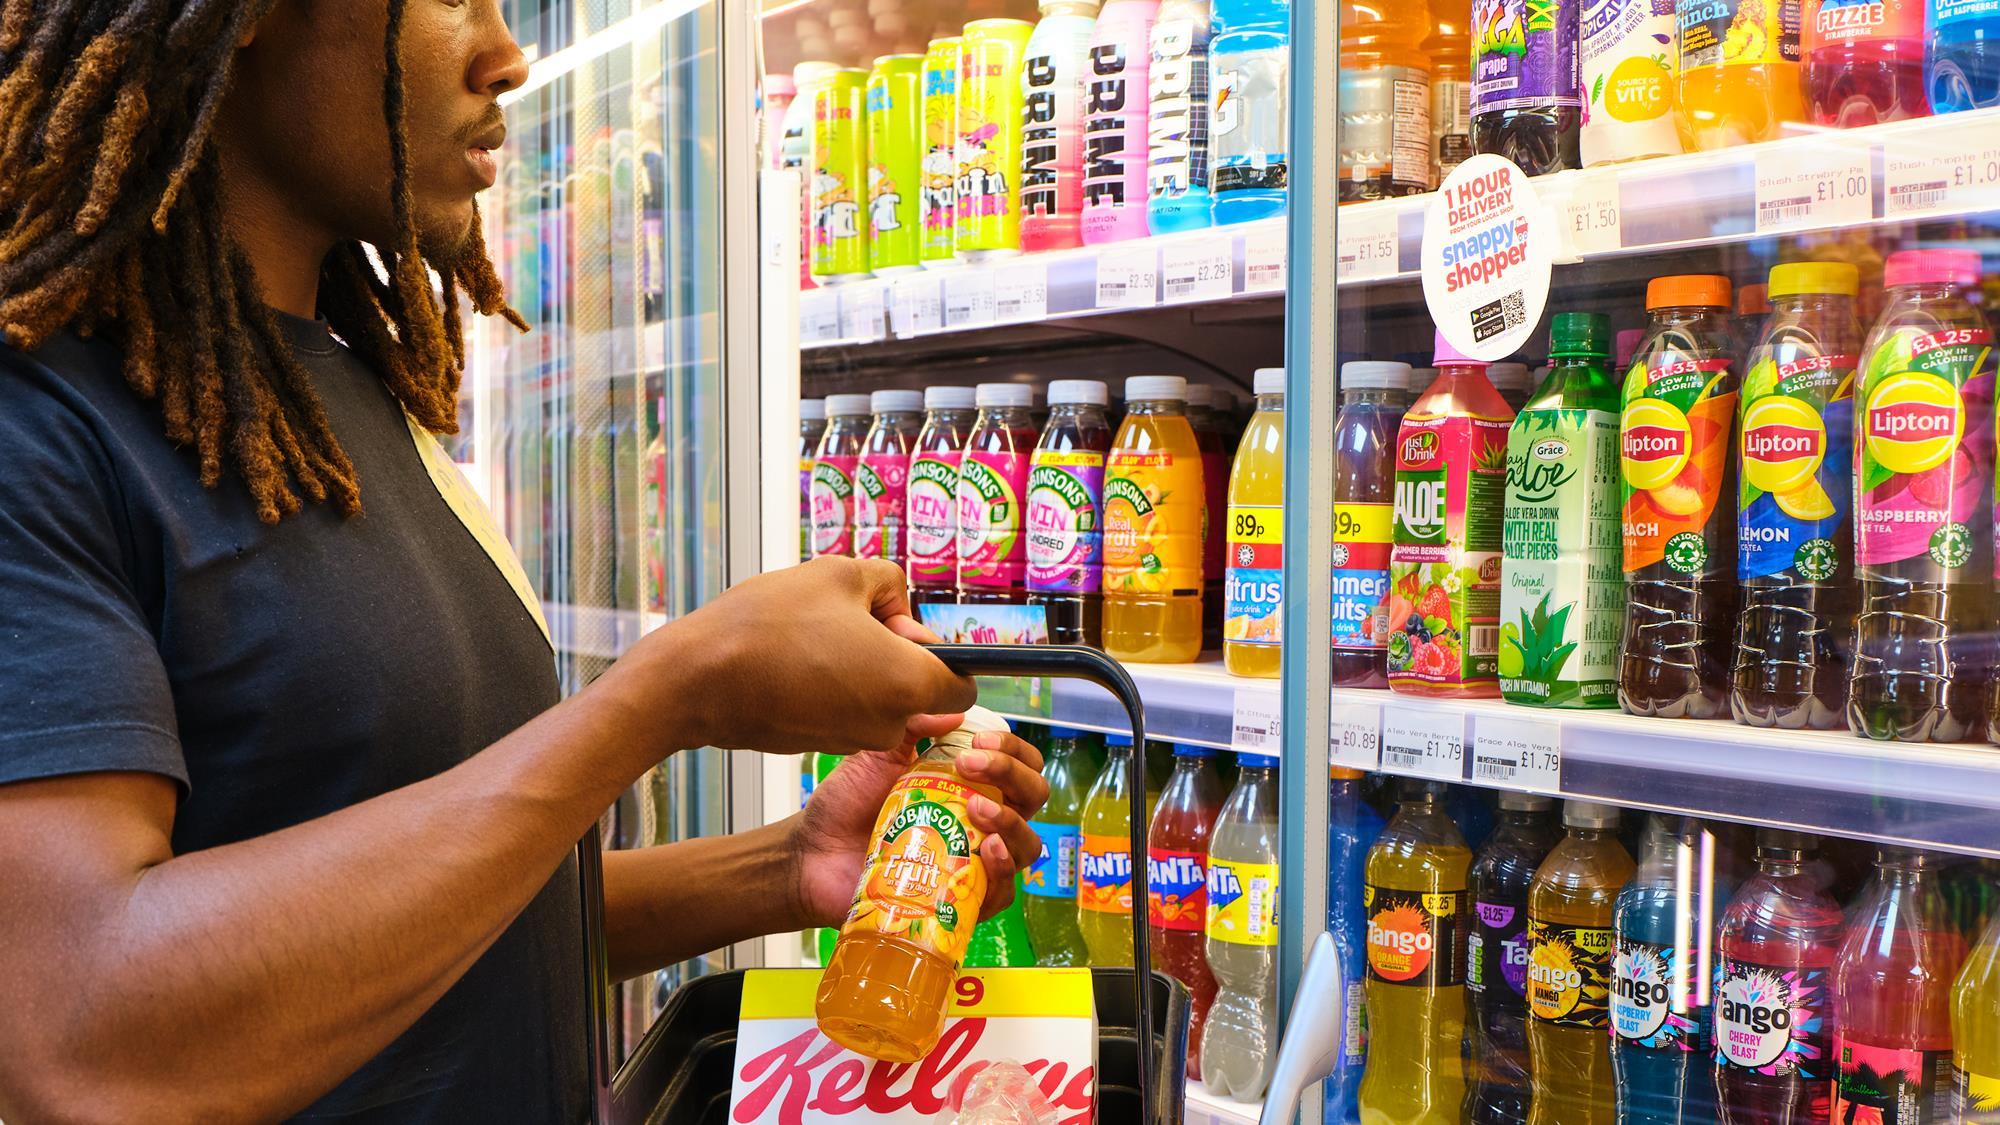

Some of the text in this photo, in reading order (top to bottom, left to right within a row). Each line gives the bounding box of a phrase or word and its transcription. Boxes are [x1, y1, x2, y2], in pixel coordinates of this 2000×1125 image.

[1624, 12, 1646, 33] WATER
[1784, 44, 1799, 56] 500
[1479, 56, 1508, 79] grape
[1648, 85, 1661, 101] C
[1148, 20, 1192, 197] PRIME
[1086, 44, 1126, 206] PRIME
[1022, 55, 1057, 216] PRIME
[1890, 162, 1925, 172] Slush
[1954, 161, 2000, 187] £1.0
[1445, 167, 1512, 209] 1 HOUR
[1760, 176, 1791, 188] Slush
[1817, 176, 1867, 202] £1.00
[1448, 187, 1513, 226] DELIVERY
[1450, 205, 1515, 235] FROM YOUR LOCAL SHOP
[1575, 208, 1617, 233] £1.50
[1359, 240, 1393, 261] £1.55
[1443, 220, 1515, 267] snappy
[1198, 263, 1226, 281] £2.29
[1446, 241, 1528, 293] shopper
[1129, 273, 1155, 289] £2.50
[1913, 330, 1972, 354] £1.25
[1921, 355, 1975, 370] CALORIES
[1929, 347, 1968, 361] LOW IN
[1649, 360, 1697, 383] £1.35
[1779, 356, 1832, 380] £1.35
[1660, 376, 1684, 387] LOW
[1785, 378, 1839, 393] CALORIES
[1793, 373, 1819, 383] LOW
[1654, 381, 1703, 395] CALORIES
[1874, 413, 1949, 436] Lipton
[1404, 435, 1423, 461] Just
[1537, 446, 1564, 456] Grace
[1624, 434, 1678, 455] Lipton
[1746, 434, 1811, 454] Lipton
[1409, 447, 1435, 460] Drink
[1506, 438, 1577, 492] aloe
[1393, 480, 1445, 527] ALOE
[1505, 507, 1559, 520] ALOE VERA DRINK
[1861, 510, 1949, 523] RASPBERRY
[1109, 516, 1130, 531] Real
[1235, 514, 1265, 537] 89p
[1505, 521, 1557, 542] WITH REAL
[1874, 525, 1892, 533] TEA
[1668, 536, 1681, 547] I'M
[1740, 527, 1789, 542] LEMON
[1396, 546, 1449, 556] SUMMER BERRIES
[1505, 542, 1558, 561] ALOE PIECES
[1800, 539, 1836, 553] I'M 100%
[1143, 554, 1155, 564] NO
[1665, 551, 1708, 572] RECYCLABLE
[1795, 559, 1839, 580] RECYCLABLE
[1511, 572, 1544, 595] Original
[1244, 606, 1261, 614] drink
[1336, 624, 1356, 632] drink
[1500, 679, 1550, 697] RICH IN VITAMIN C
[1580, 684, 1604, 697] NATURAL
[1344, 730, 1376, 750] £0.89
[1409, 729, 1428, 738] Vera
[1427, 740, 1461, 760] £1.79
[1478, 736, 1552, 752] Grace Aloe Vera
[1521, 751, 1559, 772] £1.79
[937, 780, 962, 793] £1.09
[903, 845, 935, 866] Real
[884, 854, 941, 888] Fruit
[915, 883, 932, 895] drop
[939, 905, 953, 915] NO
[1367, 920, 1432, 954] Tango
[1583, 932, 1608, 947] £1.25
[1377, 951, 1412, 965] ORANGE
[1535, 987, 1559, 1002] MANGO
[1614, 1002, 1652, 1021] ASPBERRY
[1619, 1018, 1639, 1032] BLAST
[1729, 1030, 1762, 1046] CHERRY
[1731, 1045, 1757, 1060] BLAST
